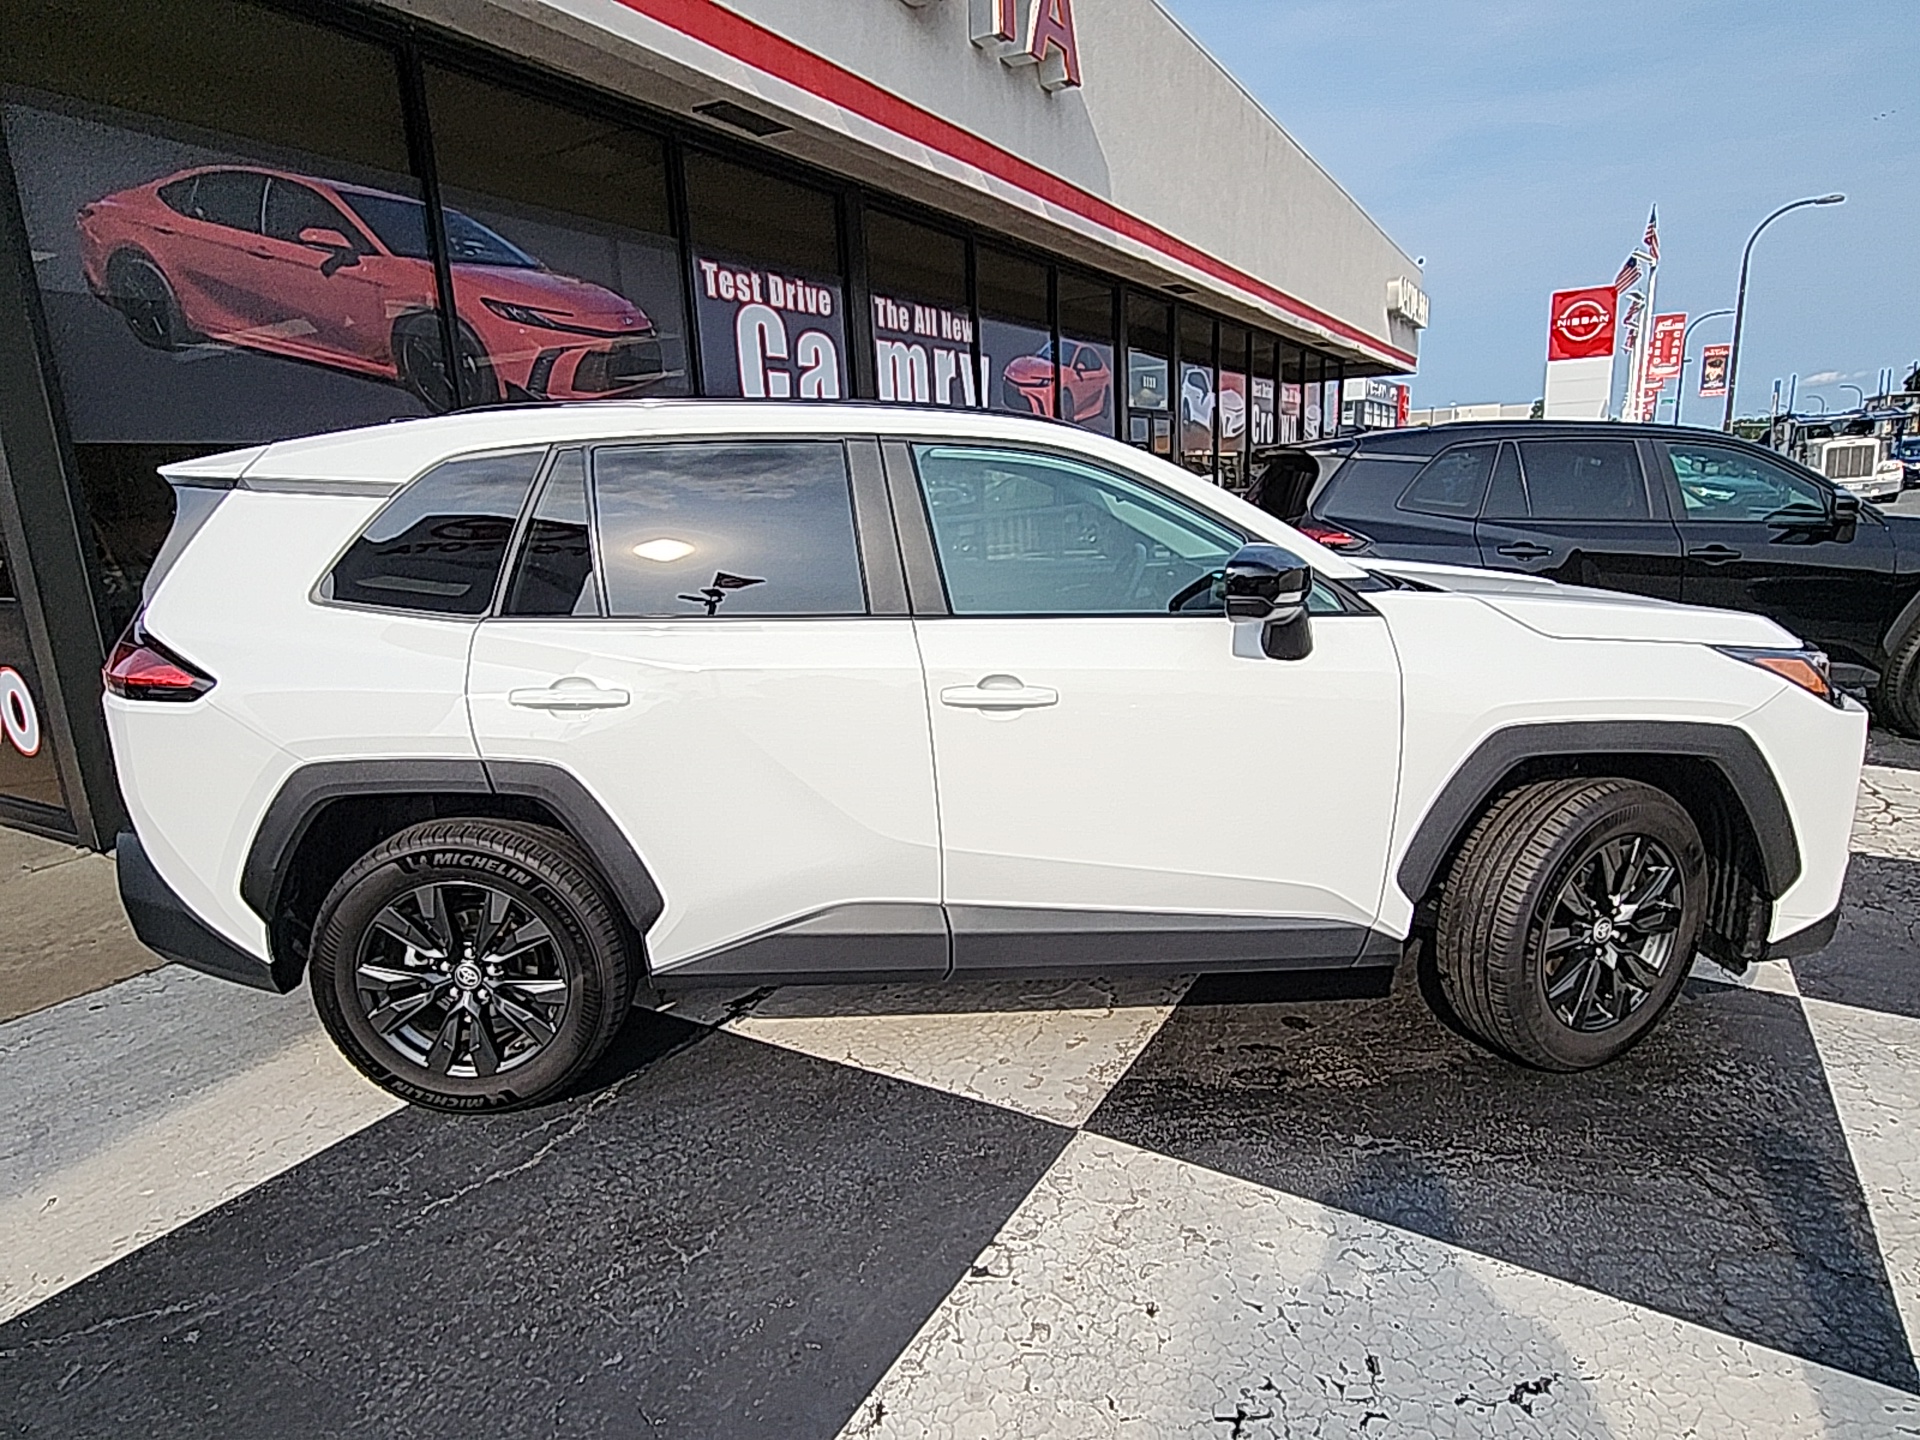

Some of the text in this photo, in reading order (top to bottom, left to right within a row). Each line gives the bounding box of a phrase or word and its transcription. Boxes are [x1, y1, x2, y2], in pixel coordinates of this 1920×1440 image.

[700, 259, 973, 343] Test Drive The All New
[1557, 314, 1609, 328] NISSAN
[433, 853, 532, 885] MICHELIN
[391, 1080, 484, 1108] MICHELIN
